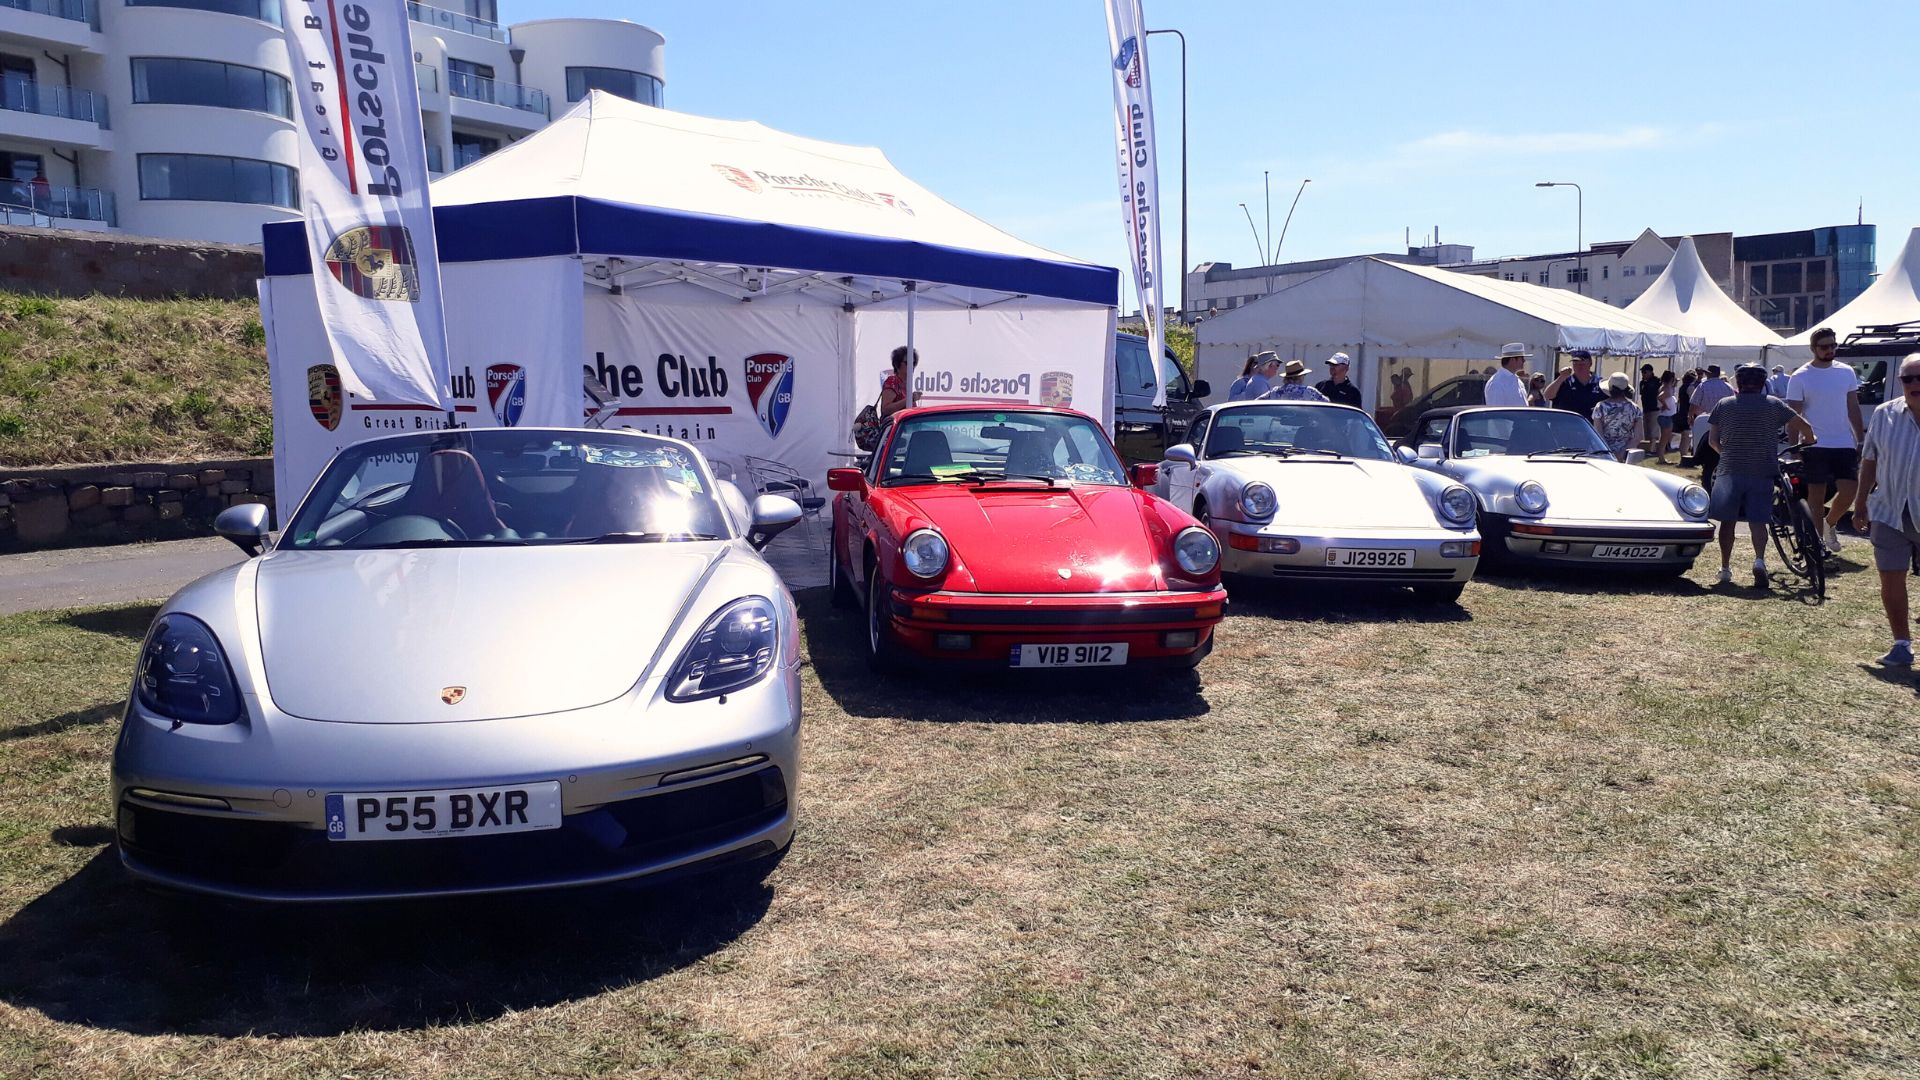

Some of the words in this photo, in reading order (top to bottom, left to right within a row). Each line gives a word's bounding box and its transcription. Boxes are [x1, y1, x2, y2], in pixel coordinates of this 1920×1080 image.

[754, 170, 834, 191] Porsche
[831, 181, 875, 202] Club
[747, 359, 792, 373] Porsche
[487, 369, 525, 381] Porsche
[657, 353, 729, 398] Club
[747, 374, 762, 383] Club
[450, 366, 476, 399] ub
[512, 397, 524, 406] GB
[777, 393, 791, 404] GB
[364, 415, 405, 429] Great
[415, 415, 468, 430] Britan
[1038, 646, 1070, 664] VIB
[1074, 645, 1113, 664] 9112
[356, 795, 437, 833] P55
[449, 789, 529, 829] BXR
[329, 820, 344, 833] GB
